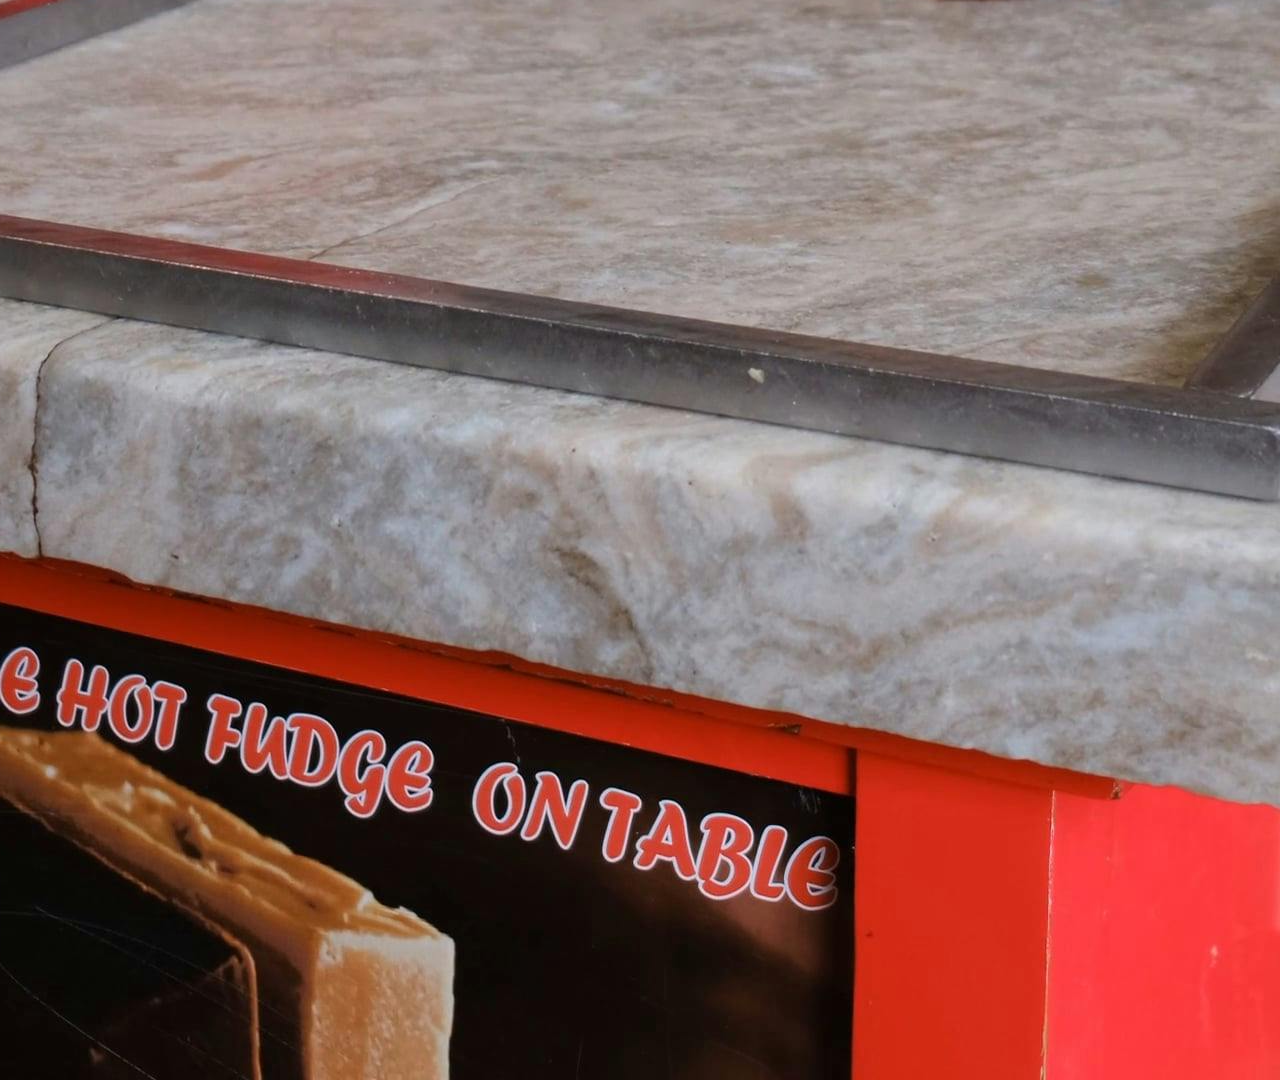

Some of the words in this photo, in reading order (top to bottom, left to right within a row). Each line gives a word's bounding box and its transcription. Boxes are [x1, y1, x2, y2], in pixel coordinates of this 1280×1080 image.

[56, 658, 188, 751] HOT
[204, 692, 436, 819] FUDGE
[472, 761, 590, 851] ON
[600, 787, 841, 911] TABLE
